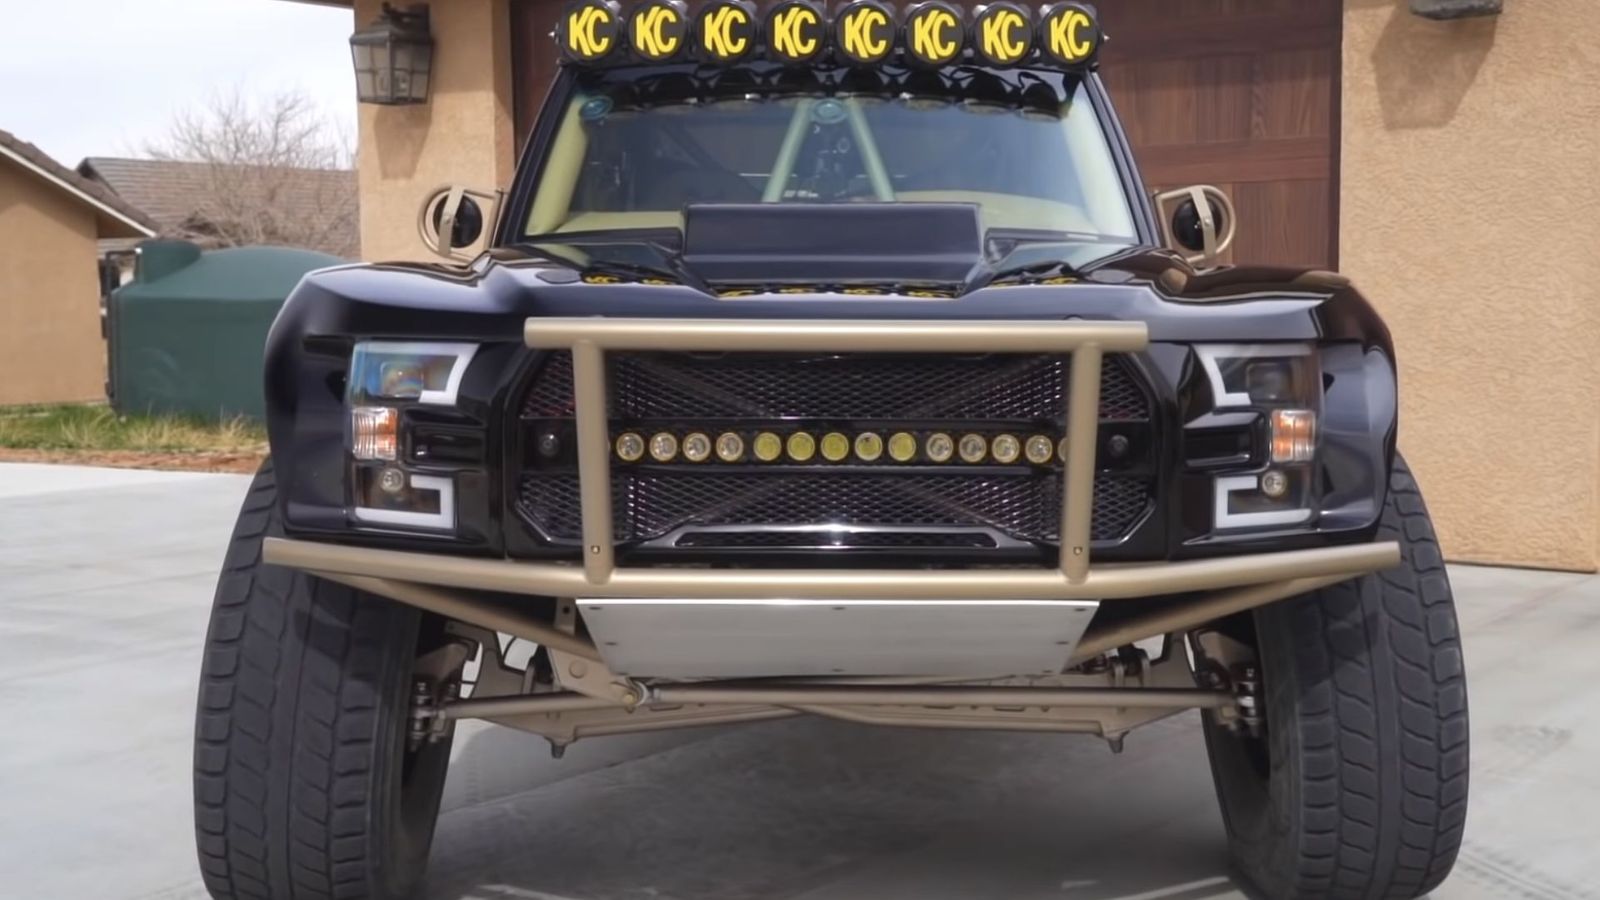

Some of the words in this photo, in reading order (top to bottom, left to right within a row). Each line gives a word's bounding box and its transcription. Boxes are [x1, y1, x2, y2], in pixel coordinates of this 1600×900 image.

[569, 6, 609, 56] KC
[636, 6, 677, 56] KC
[705, 6, 746, 57] KC
[774, 7, 816, 57] KC
[845, 8, 887, 58] KC
[914, 10, 956, 60] KC
[983, 10, 1024, 60] KC
[1050, 10, 1090, 59] KC
